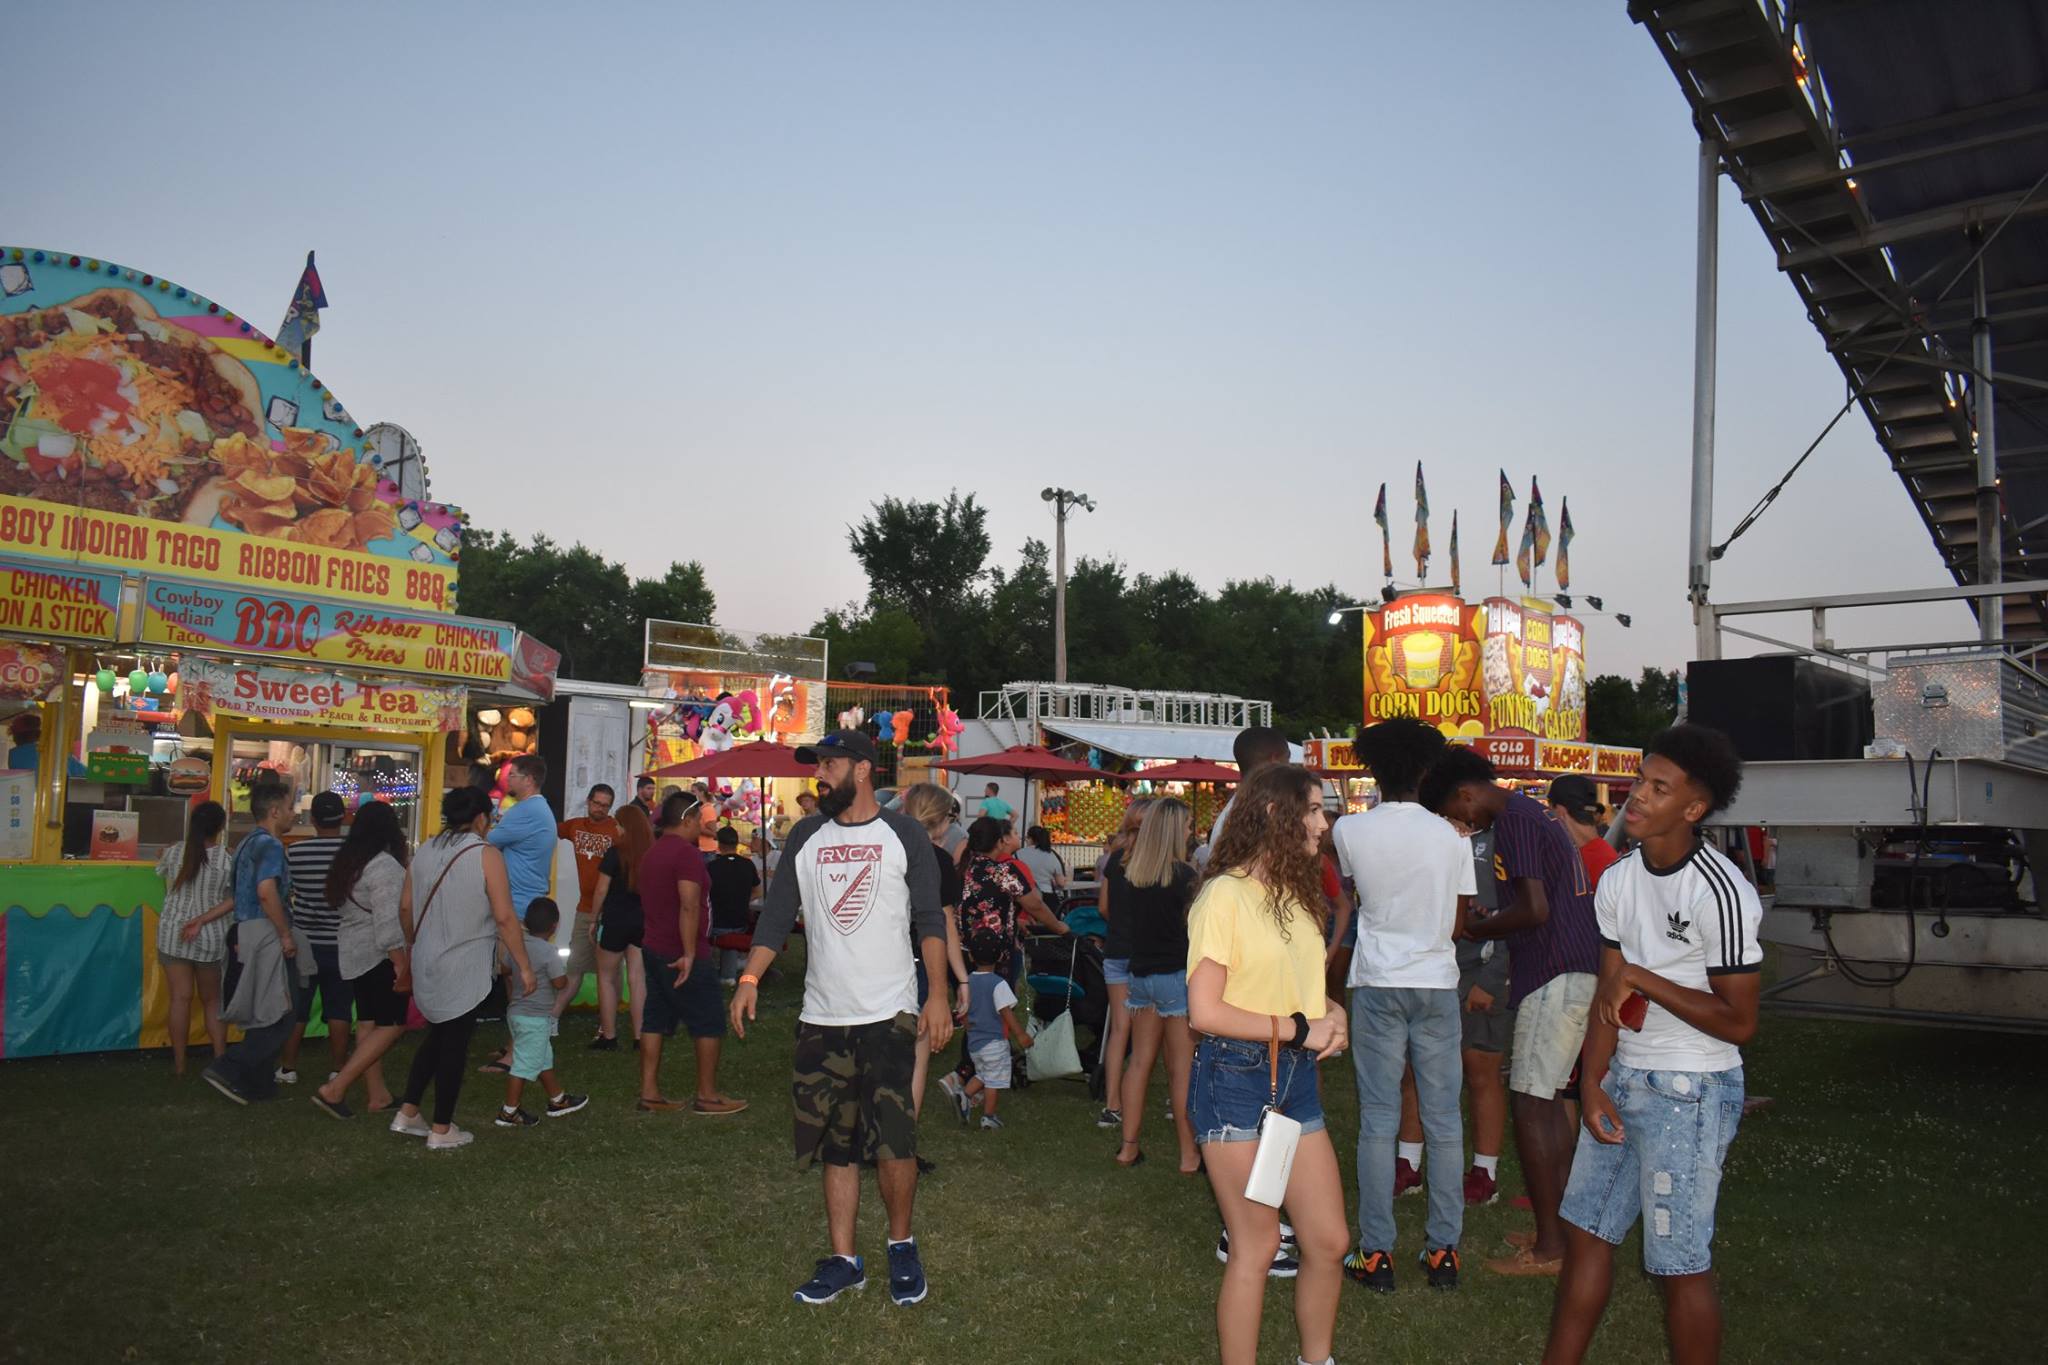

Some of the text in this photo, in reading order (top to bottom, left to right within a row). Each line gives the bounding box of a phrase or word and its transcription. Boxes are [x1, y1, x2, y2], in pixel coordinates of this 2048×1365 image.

[0, 505, 445, 610] BOY INDIAN TACO RIBBON FRIES BBQ
[11, 569, 100, 605] CHICKEN
[155, 587, 223, 615] Cowboy
[29, 602, 43, 628] A
[49, 604, 110, 636] STICK
[160, 606, 214, 627] Indian
[234, 597, 320, 657] BBQ
[335, 611, 422, 639] Ribbon
[1384, 603, 1460, 631] Fresh Squeezed
[1526, 617, 1550, 644] CORN
[166, 625, 206, 644] Taco
[435, 624, 499, 652] CHICKEN
[346, 636, 406, 665] Fries
[425, 647, 445, 670] ON
[449, 653, 459, 672] A
[463, 653, 505, 677] STICK
[1526, 645, 1550, 670] DOGS
[234, 669, 418, 714] Sweet Tea
[1369, 689, 1481, 719] CORN DOGS
[359, 711, 368, 722] &
[1489, 693, 1581, 740] FUNNEL CAKES
[1488, 754, 1530, 766] RINKS
[1489, 741, 1524, 753] COLD
[1542, 746, 1591, 769] NACHOS
[820, 847, 879, 862] RVCA
